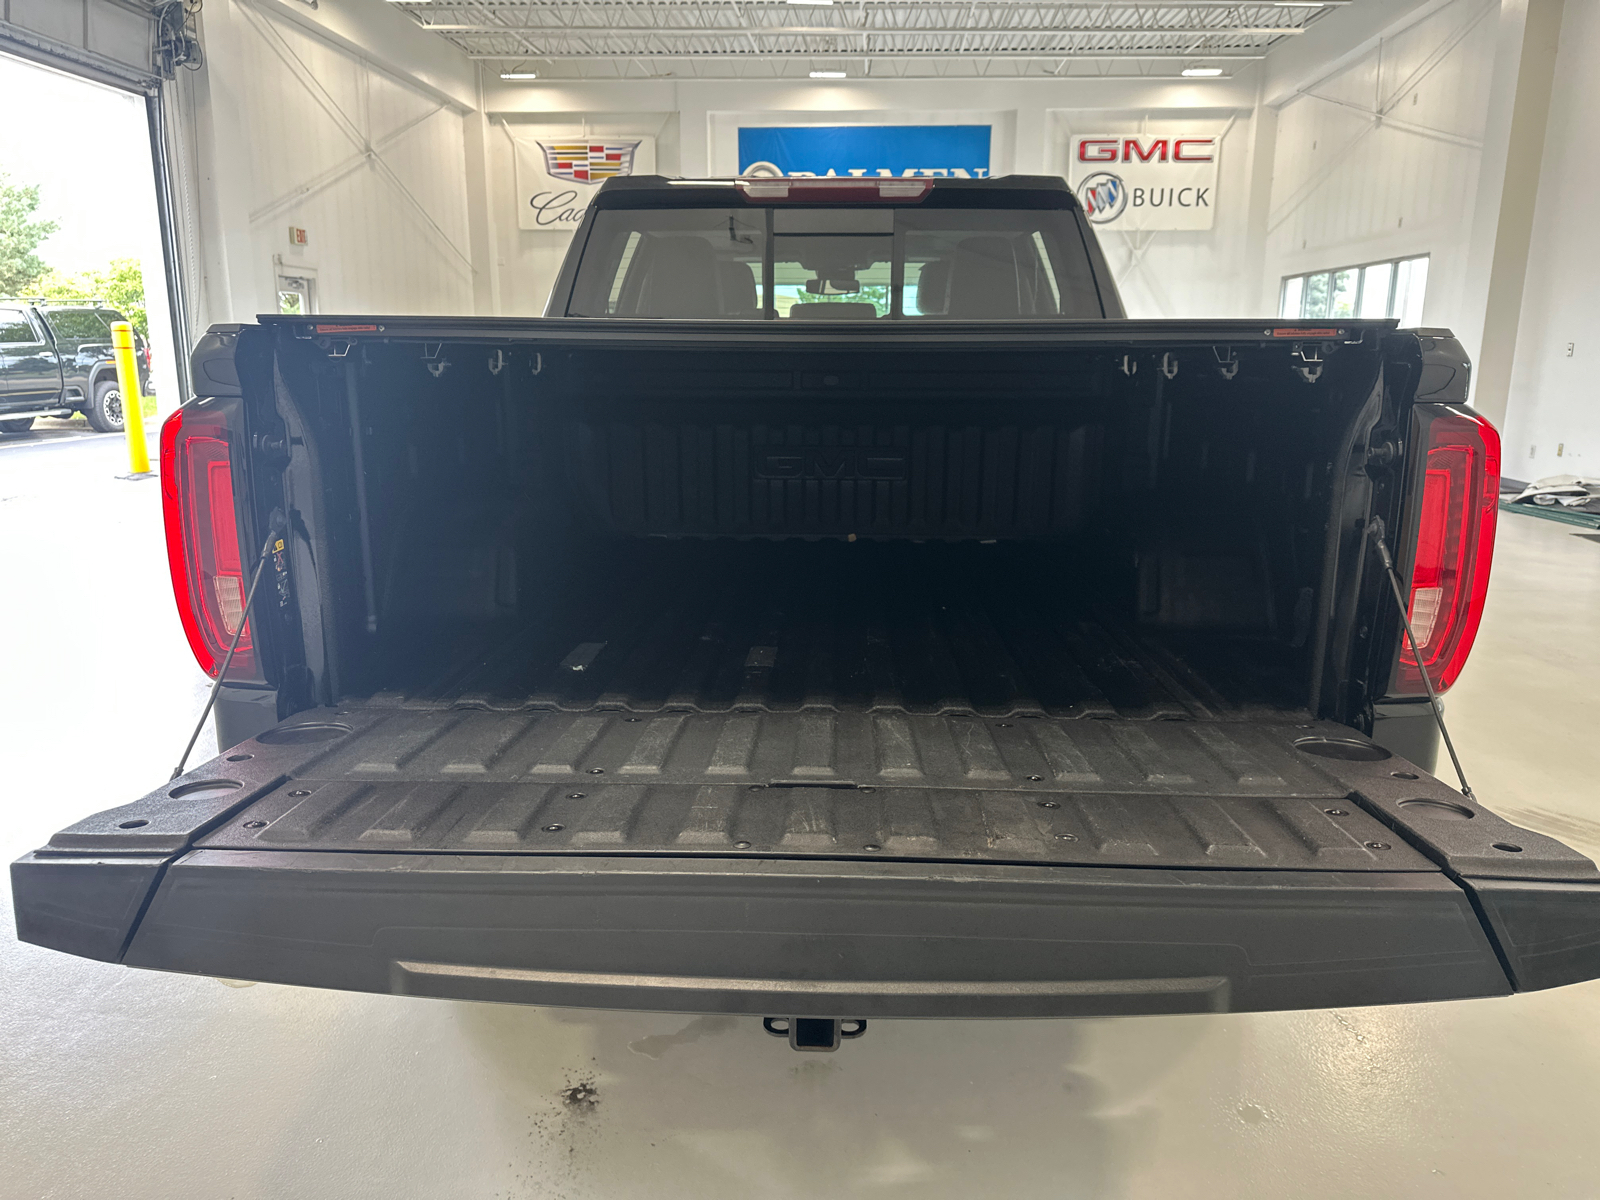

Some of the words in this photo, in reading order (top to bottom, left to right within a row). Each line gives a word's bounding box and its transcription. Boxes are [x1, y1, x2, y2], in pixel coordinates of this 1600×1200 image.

[1078, 137, 1216, 164] GMC
[1132, 187, 1210, 207] BUICK
[755, 450, 905, 479] GMC
